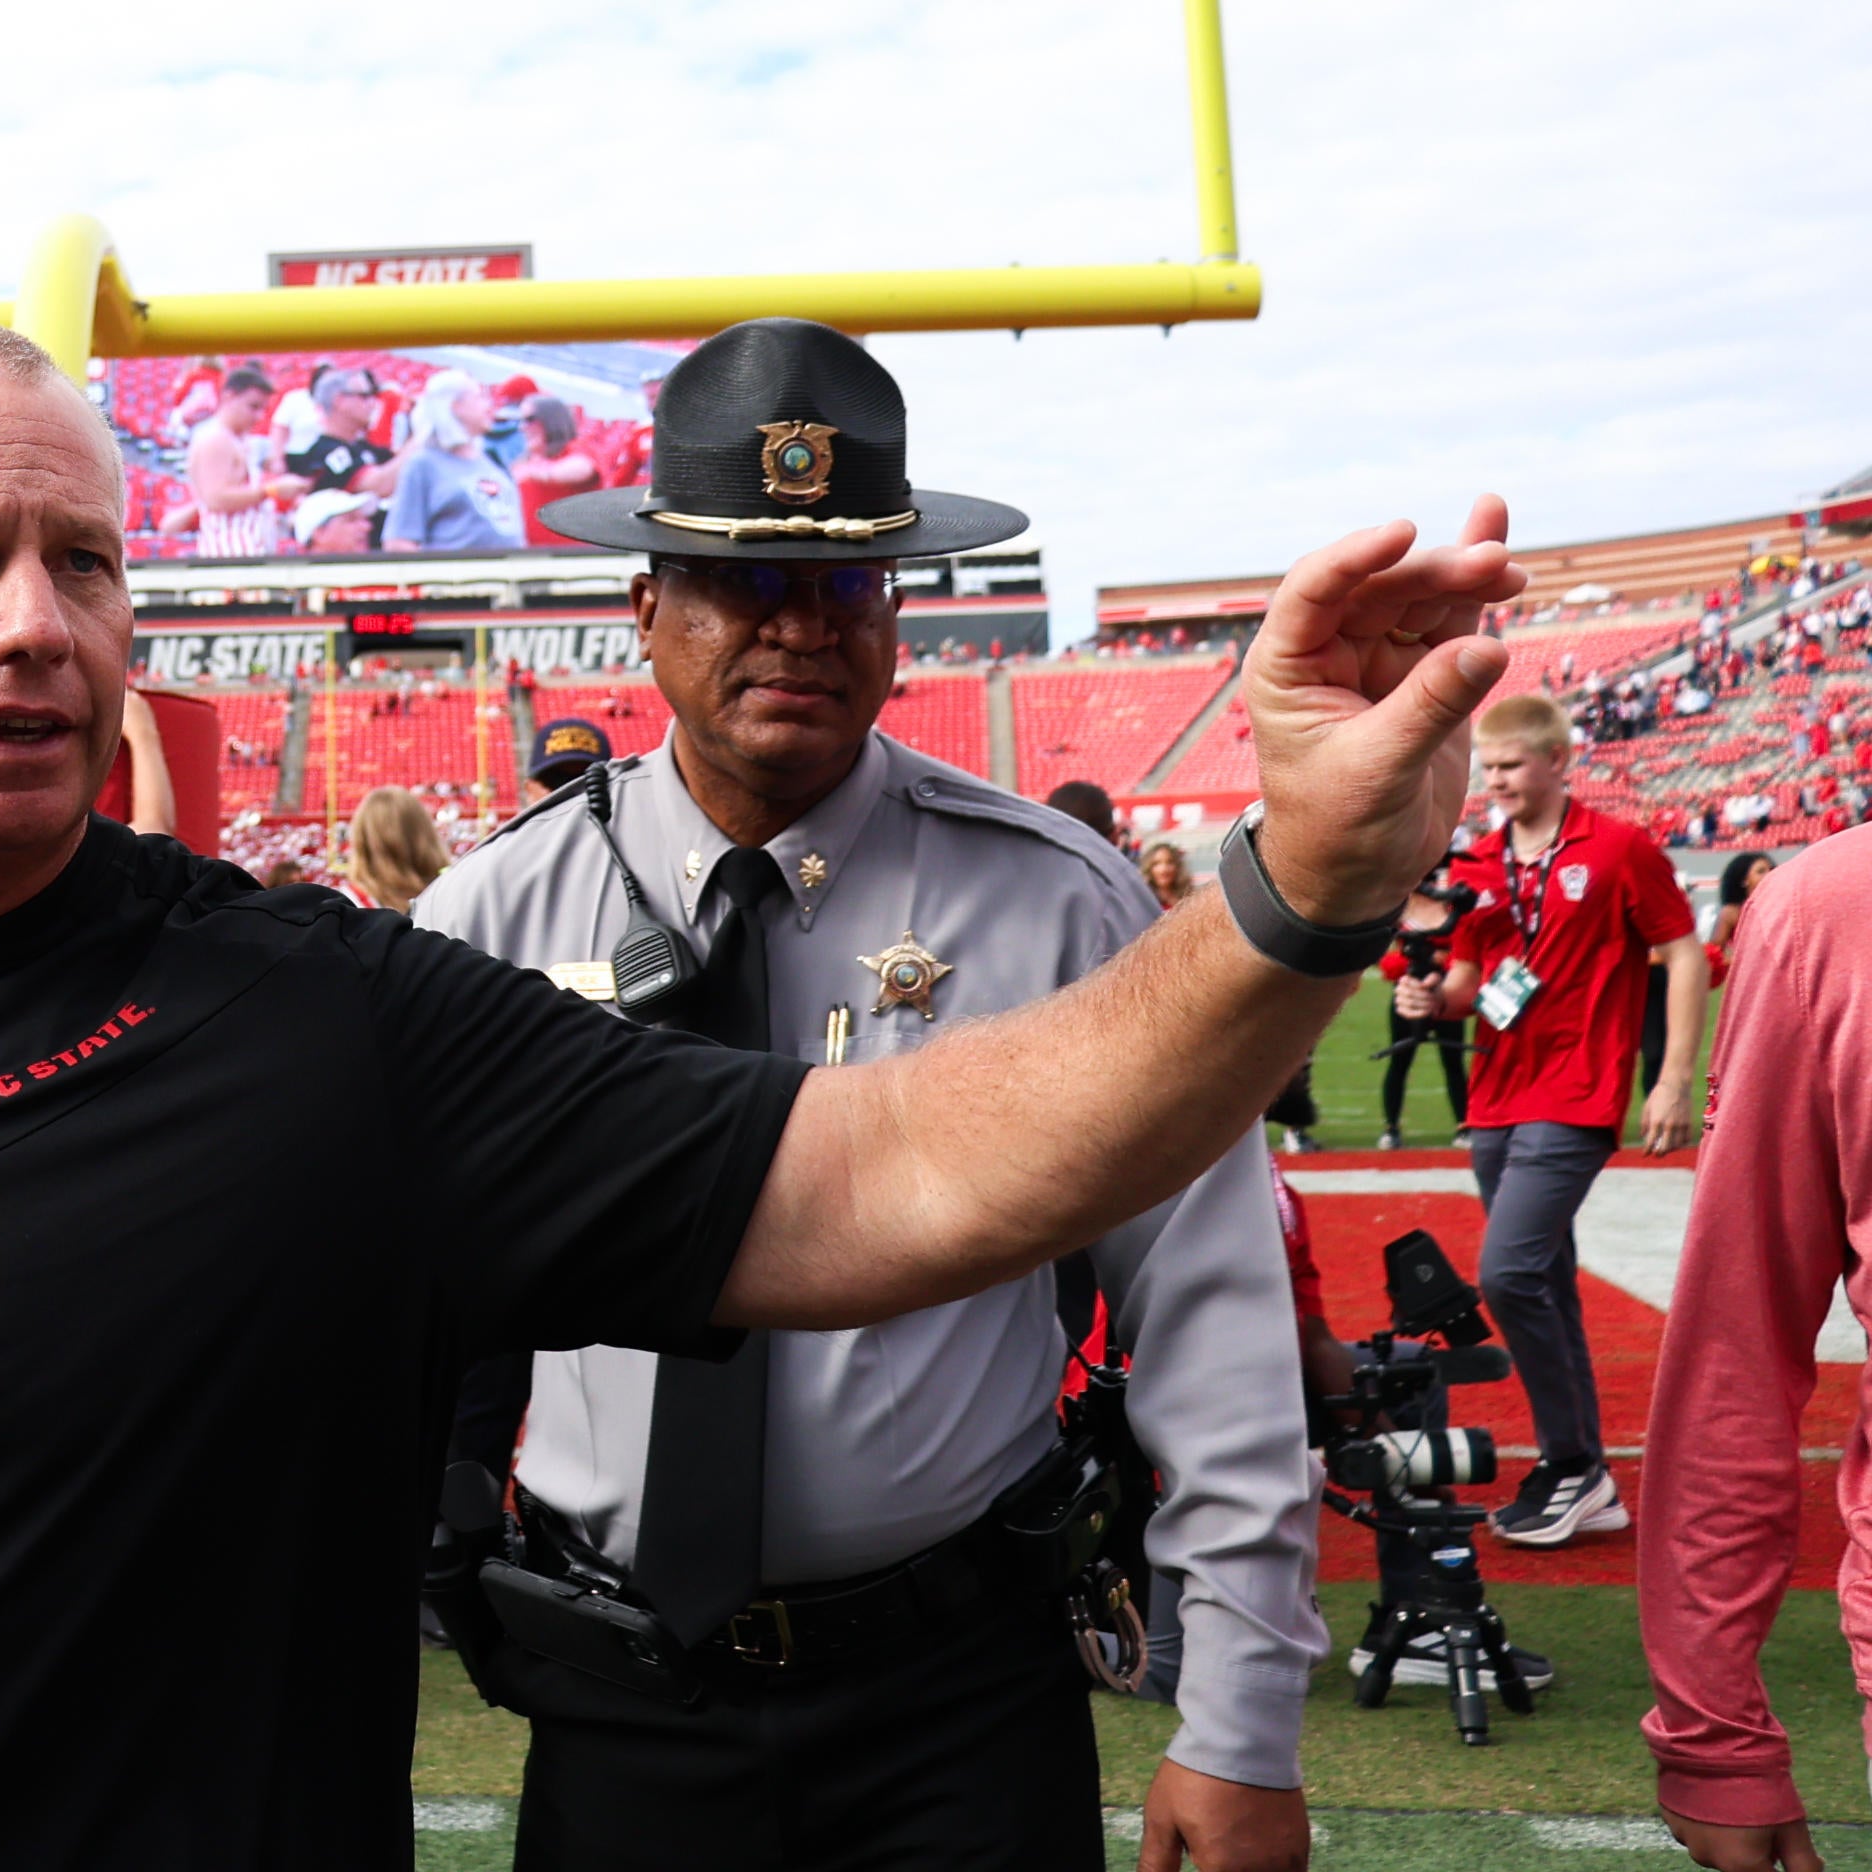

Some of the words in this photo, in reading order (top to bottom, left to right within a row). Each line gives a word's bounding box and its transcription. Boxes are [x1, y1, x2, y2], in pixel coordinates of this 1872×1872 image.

[314, 263, 369, 288] NC
[374, 256, 489, 286] STATE
[148, 637, 206, 679] NC
[207, 633, 329, 680] STATE
[26, 1000, 149, 1080] STATE
